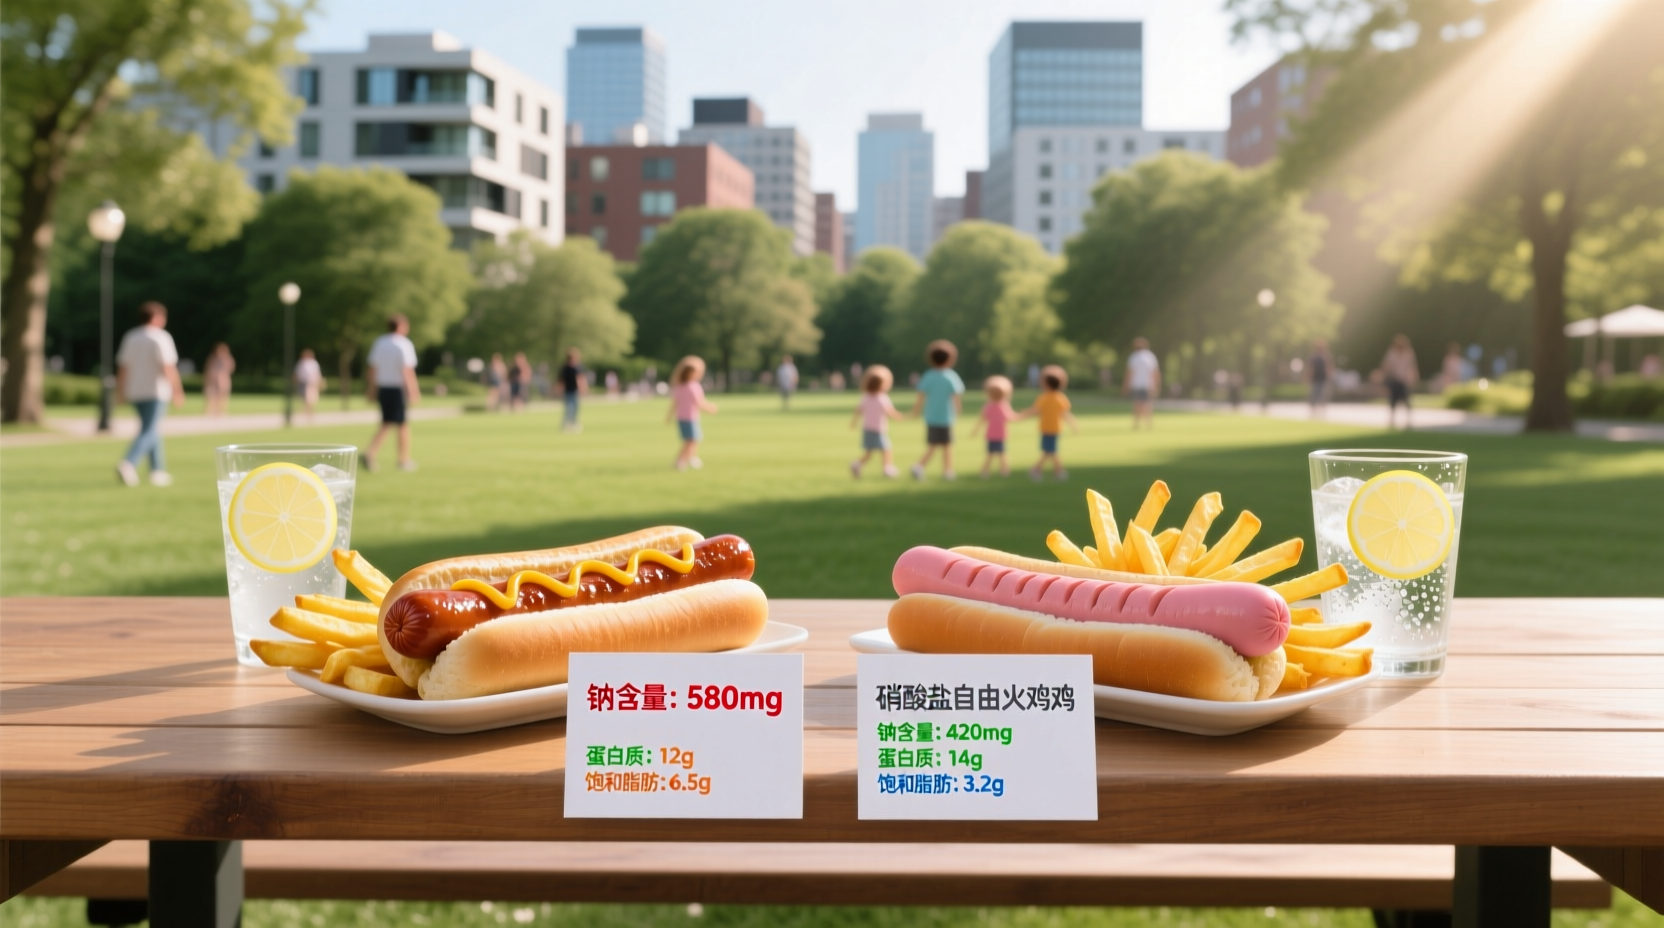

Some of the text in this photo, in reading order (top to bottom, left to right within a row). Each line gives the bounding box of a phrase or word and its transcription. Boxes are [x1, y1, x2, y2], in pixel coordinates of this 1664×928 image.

[687, 684, 783, 717] 580mg
[875, 682, 1076, 712] 硝酸盐自由火鸡鸡
[945, 723, 1013, 745] 420mg
[659, 746, 694, 770] 12g
[948, 749, 983, 772] 14g
[963, 774, 1005, 797] 3.2g
